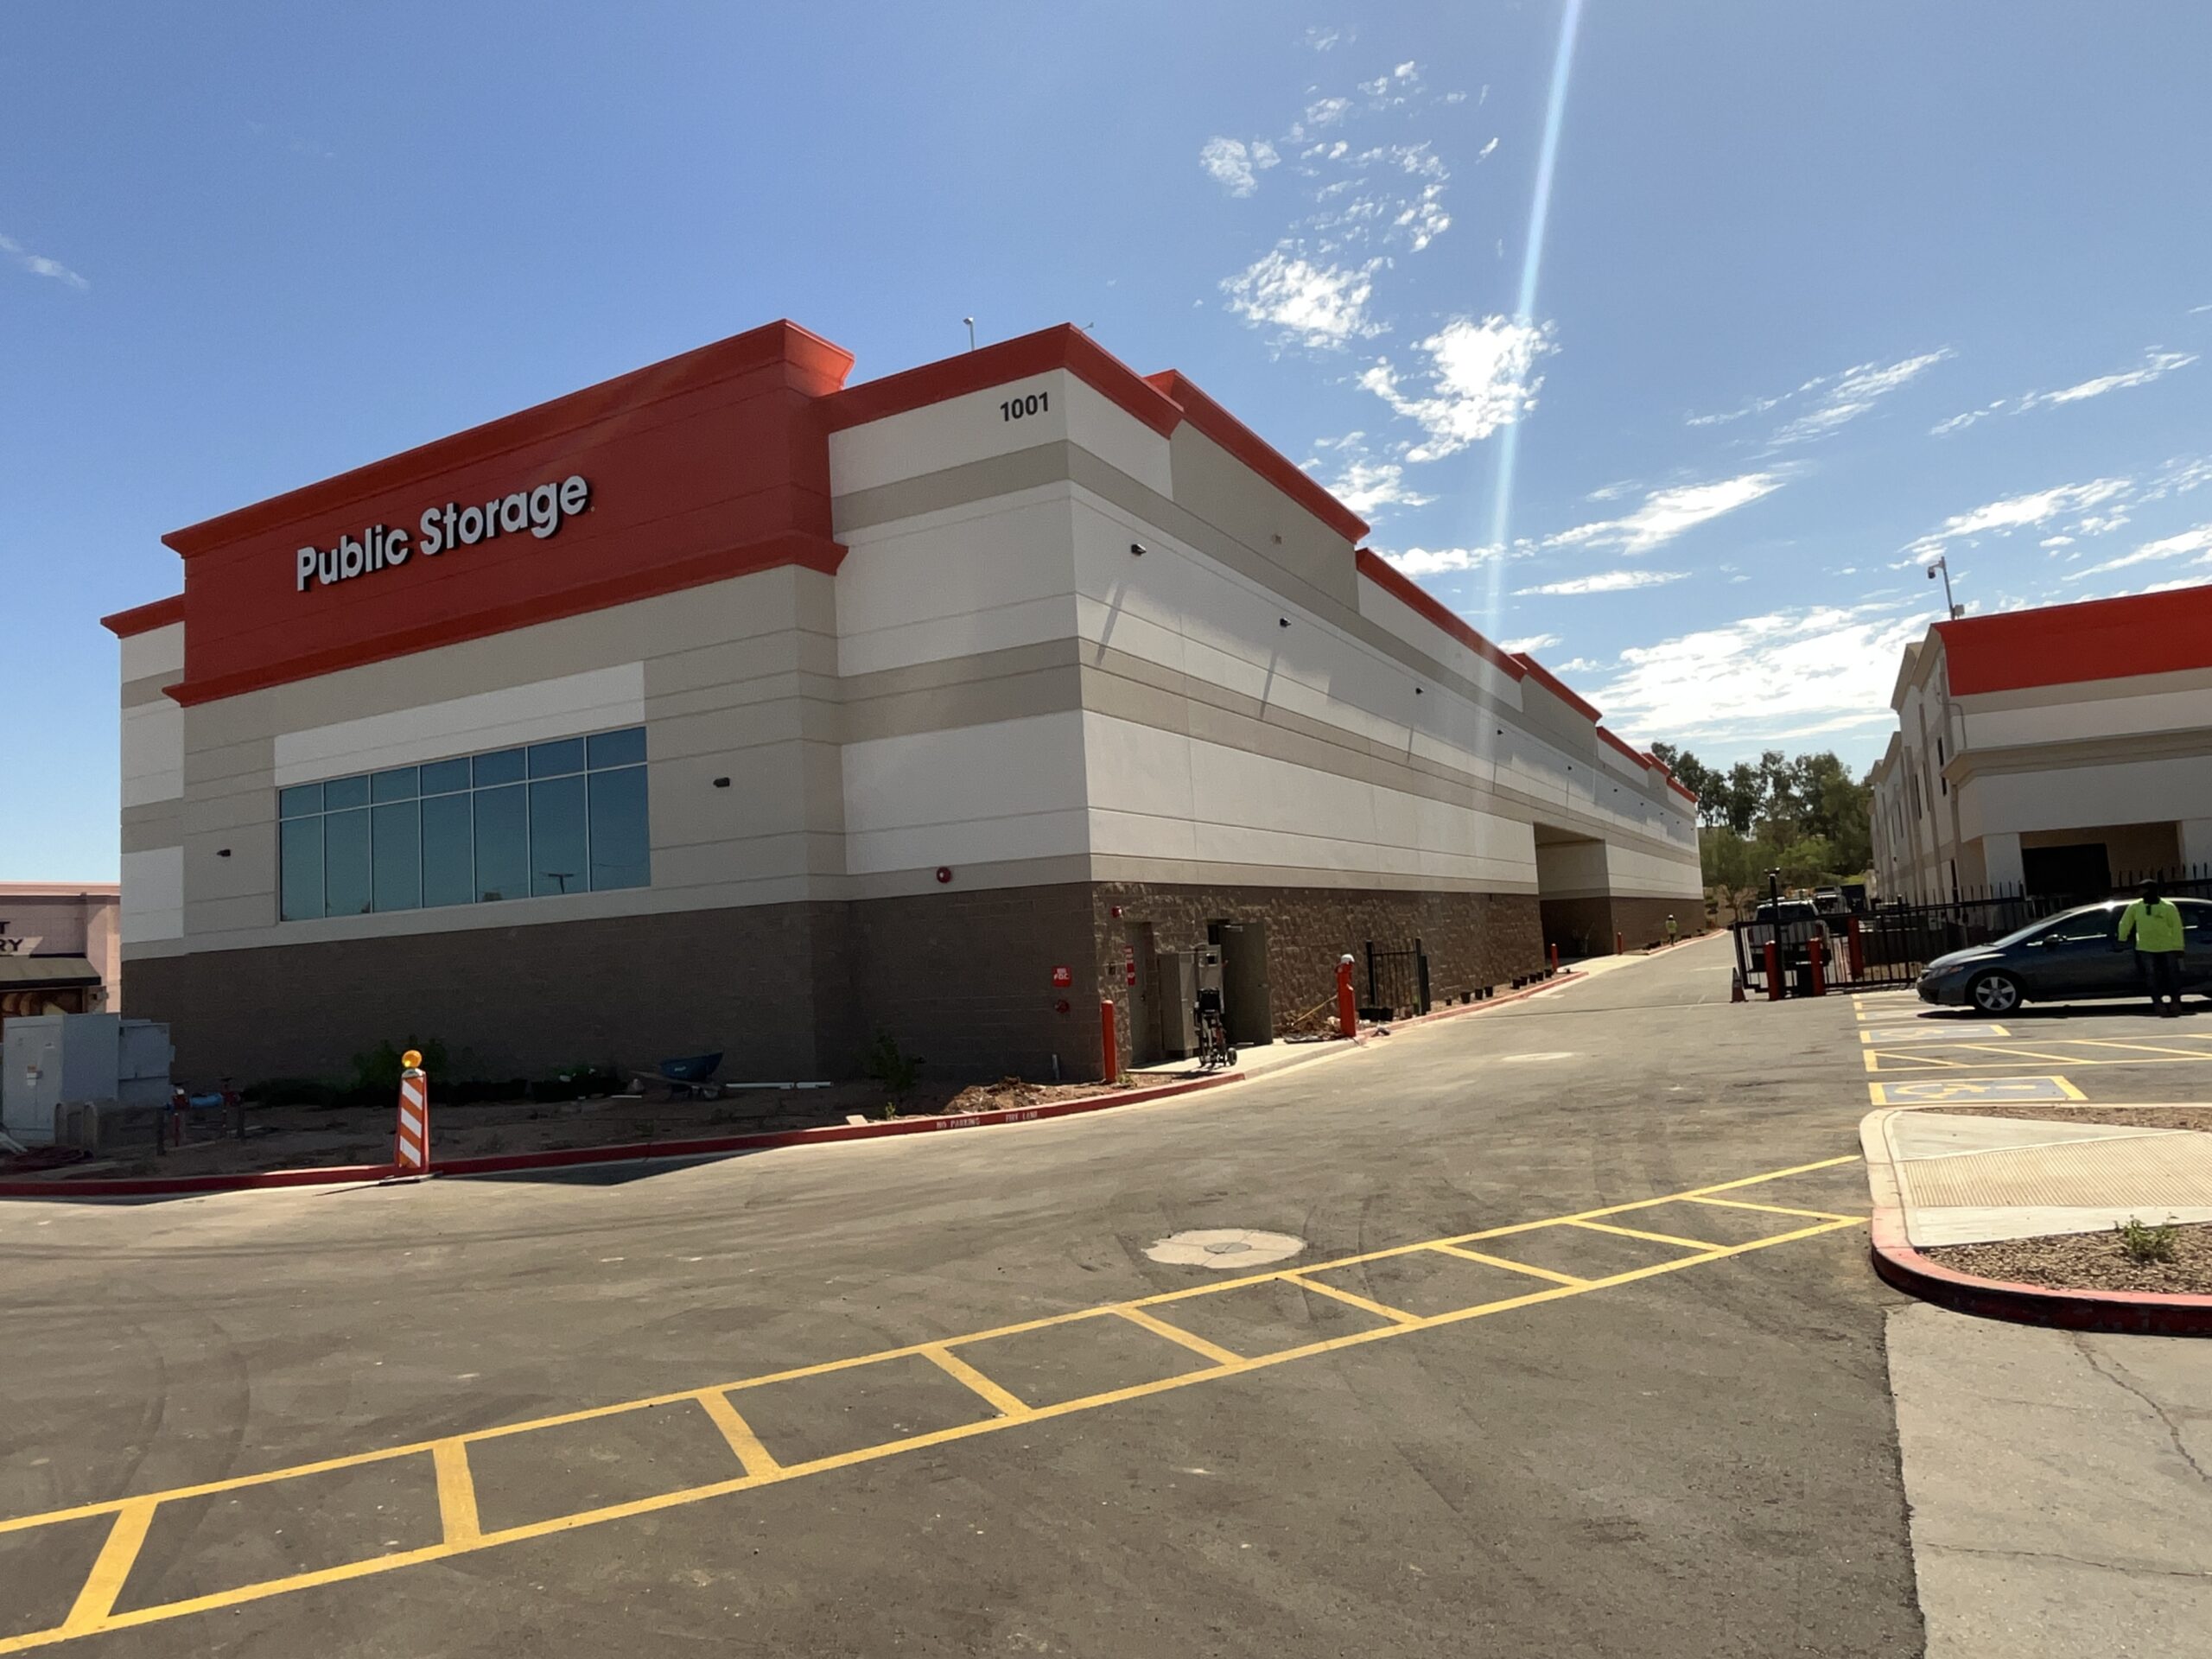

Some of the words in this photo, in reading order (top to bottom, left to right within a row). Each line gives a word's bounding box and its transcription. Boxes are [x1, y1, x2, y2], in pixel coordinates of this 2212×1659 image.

[1000, 391, 1048, 422] 1001
[296, 524, 410, 592] Public
[419, 474, 588, 556] Storage
